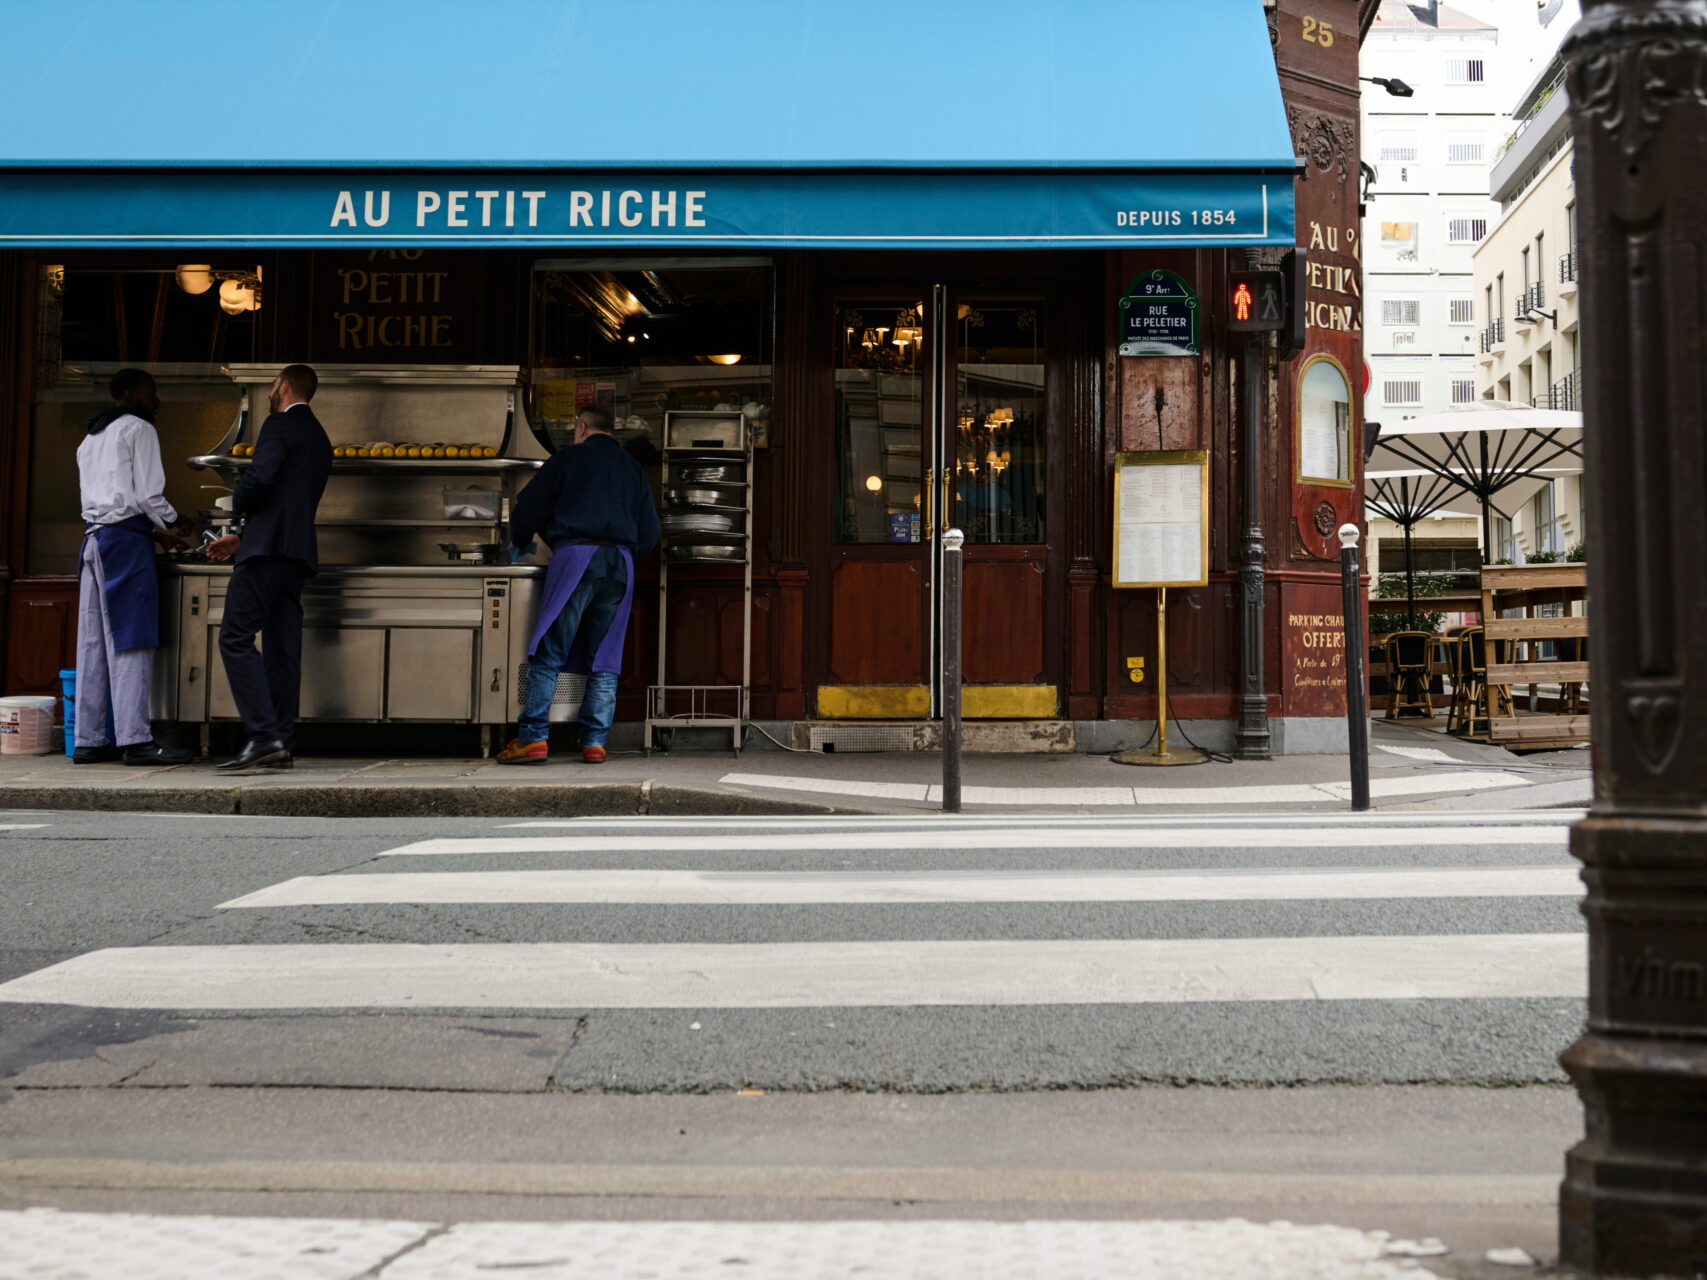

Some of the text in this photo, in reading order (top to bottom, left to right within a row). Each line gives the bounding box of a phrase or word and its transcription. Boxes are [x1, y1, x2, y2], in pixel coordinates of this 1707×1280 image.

[1302, 16, 1334, 48] 25
[330, 190, 706, 228] AU PETIT RICHE
[1117, 210, 1236, 226] DEPUIS 1854
[1310, 220, 1338, 252] AU
[336, 268, 449, 305] PETIT
[1130, 318, 1186, 327] LE PELETIER
[1149, 306, 1168, 316] RUE
[332, 312, 454, 351] RICHE
[1289, 614, 1323, 626] PARKING
